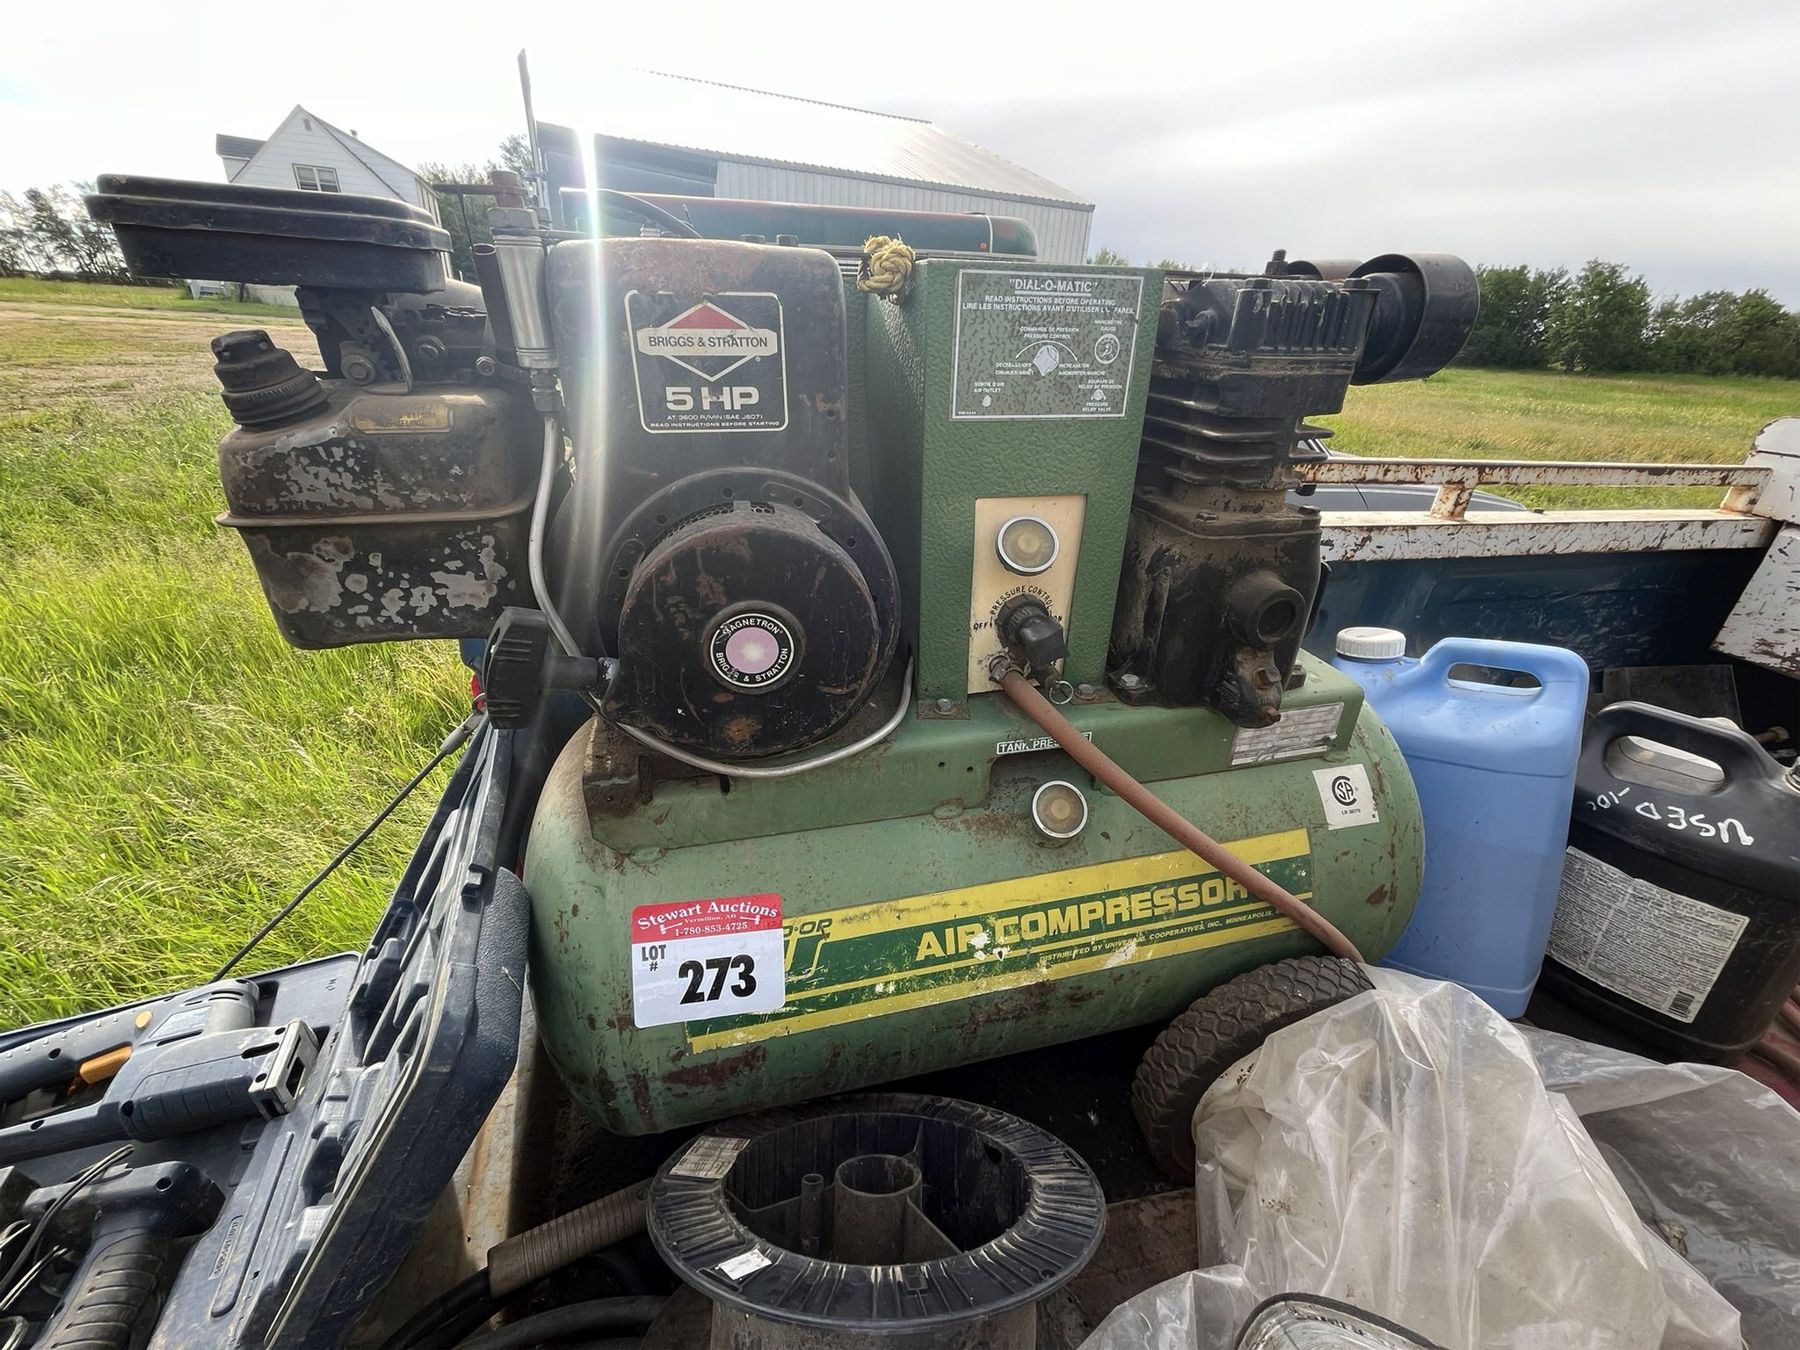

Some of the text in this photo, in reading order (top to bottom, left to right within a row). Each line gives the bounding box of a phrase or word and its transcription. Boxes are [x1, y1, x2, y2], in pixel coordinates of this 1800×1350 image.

[962, 302, 978, 310] LIRE
[993, 303, 1041, 311] INSTRUCTIONS
[1004, 296, 1052, 304] INSTRUCTIONS
[1053, 297, 1080, 305] BEFORE
[1080, 298, 1116, 306] OPERATING
[648, 336, 768, 348] BRIGGS & STRATTON
[665, 386, 760, 411] 5 HP
[989, 585, 1053, 616] PRESSURE CONTROL
[973, 622, 989, 630] OFF
[755, 648, 789, 681] STRATTON
[1000, 742, 1029, 753] TANK
[1634, 801, 1755, 846] USED
[637, 901, 778, 930] Stewart Auctions
[916, 876, 1249, 961] AIR COMPRESSOR
[674, 921, 748, 937] 1-780-853-4725
[641, 944, 667, 962] LOT
[1040, 947, 1090, 962] DISTRIBUTED
[1092, 943, 1103, 952] BY
[649, 961, 659, 972] #
[678, 954, 757, 1005] 273
